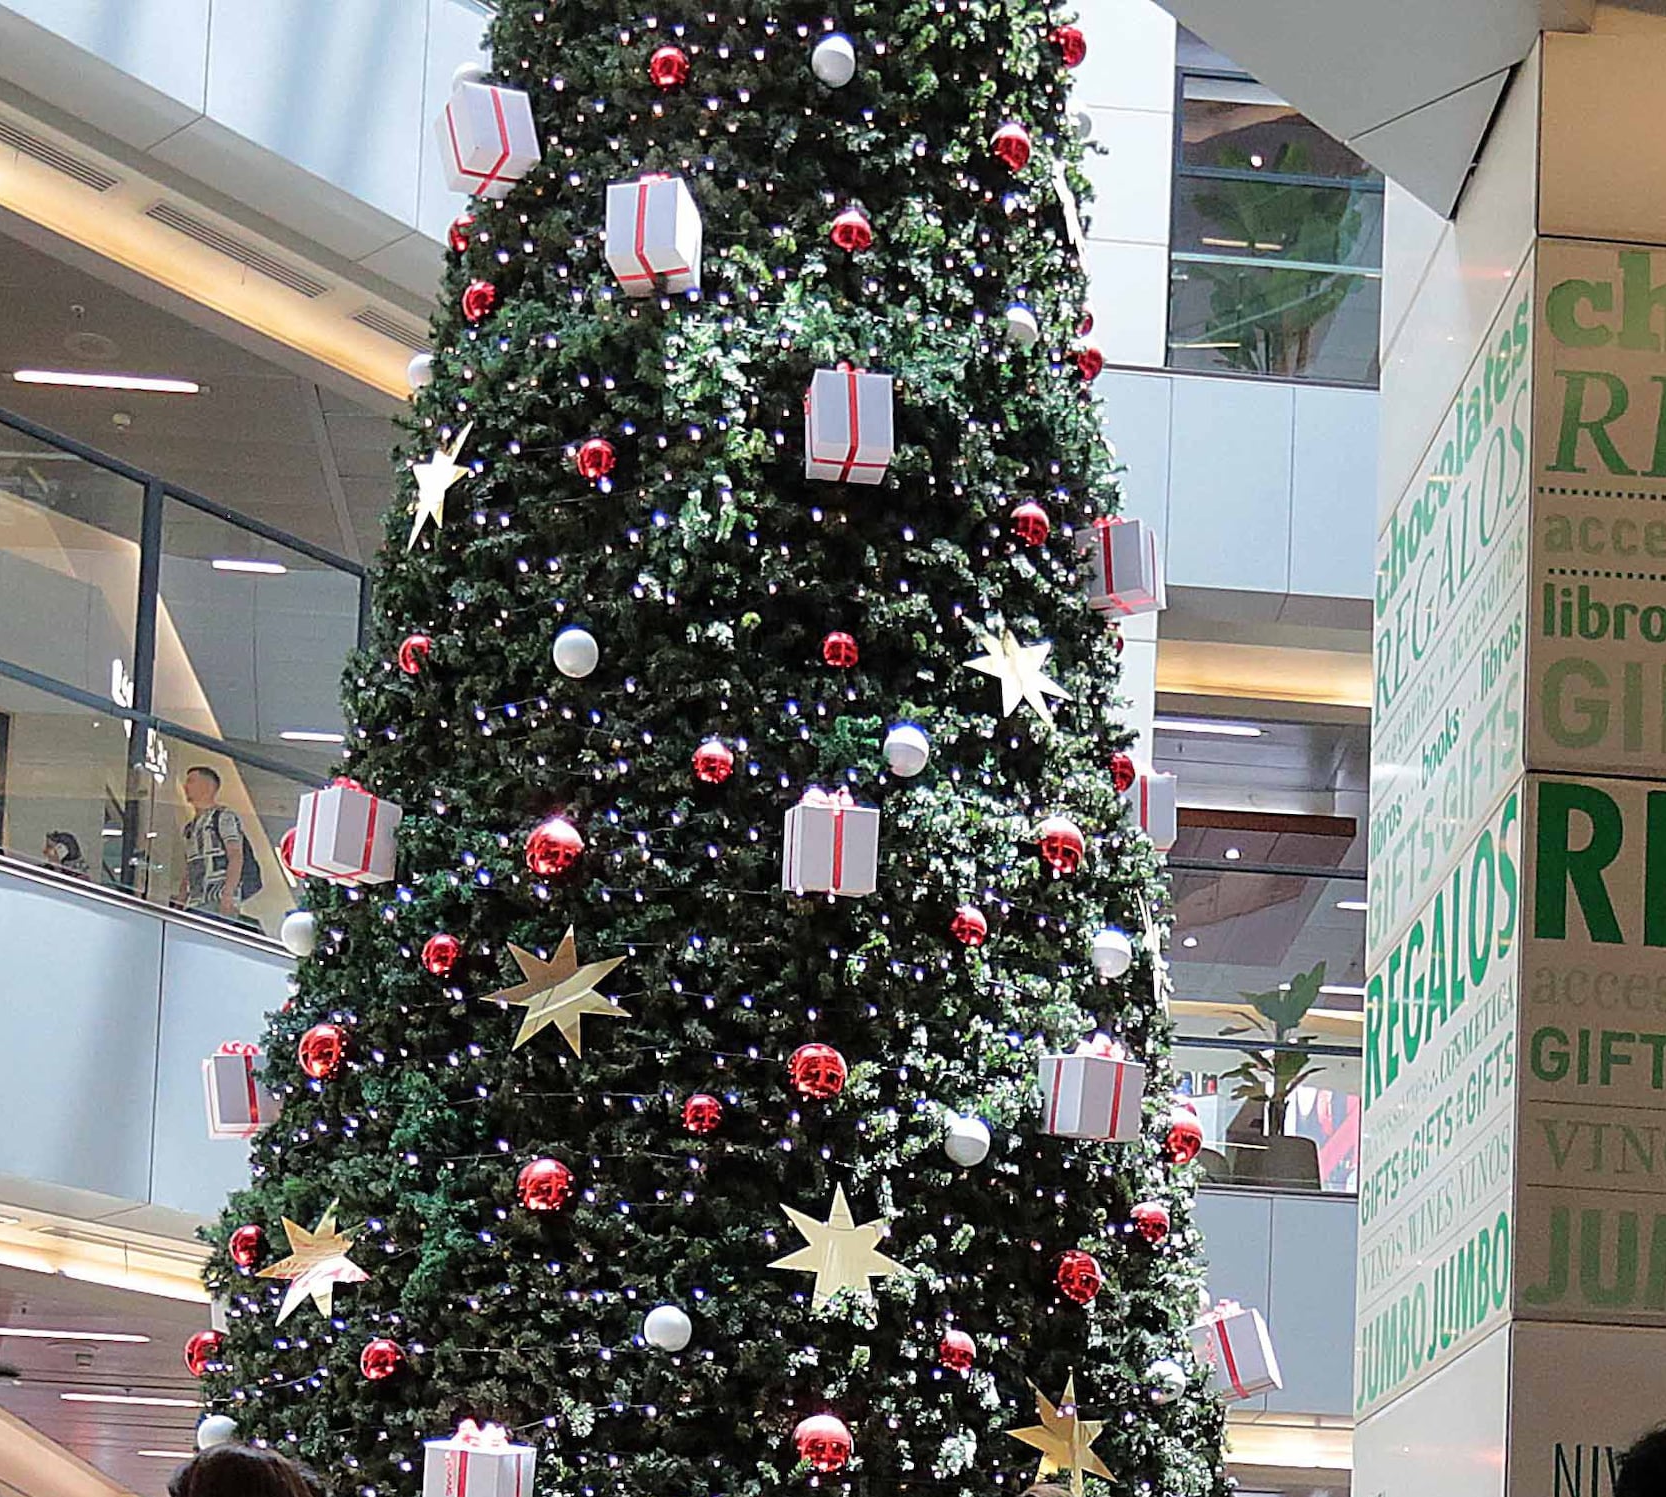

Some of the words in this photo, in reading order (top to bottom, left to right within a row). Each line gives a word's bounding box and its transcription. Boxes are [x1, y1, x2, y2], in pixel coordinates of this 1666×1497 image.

[1375, 289, 1528, 618] chocolates
[1375, 378, 1528, 728] REGALOS
[1481, 610, 1522, 701] libros
[1365, 791, 1518, 1112] REGALOS
[1466, 1030, 1515, 1125] GIFTS
[1356, 1281, 1427, 1411] JUMBO
[1427, 1211, 1510, 1362] JUMBO
